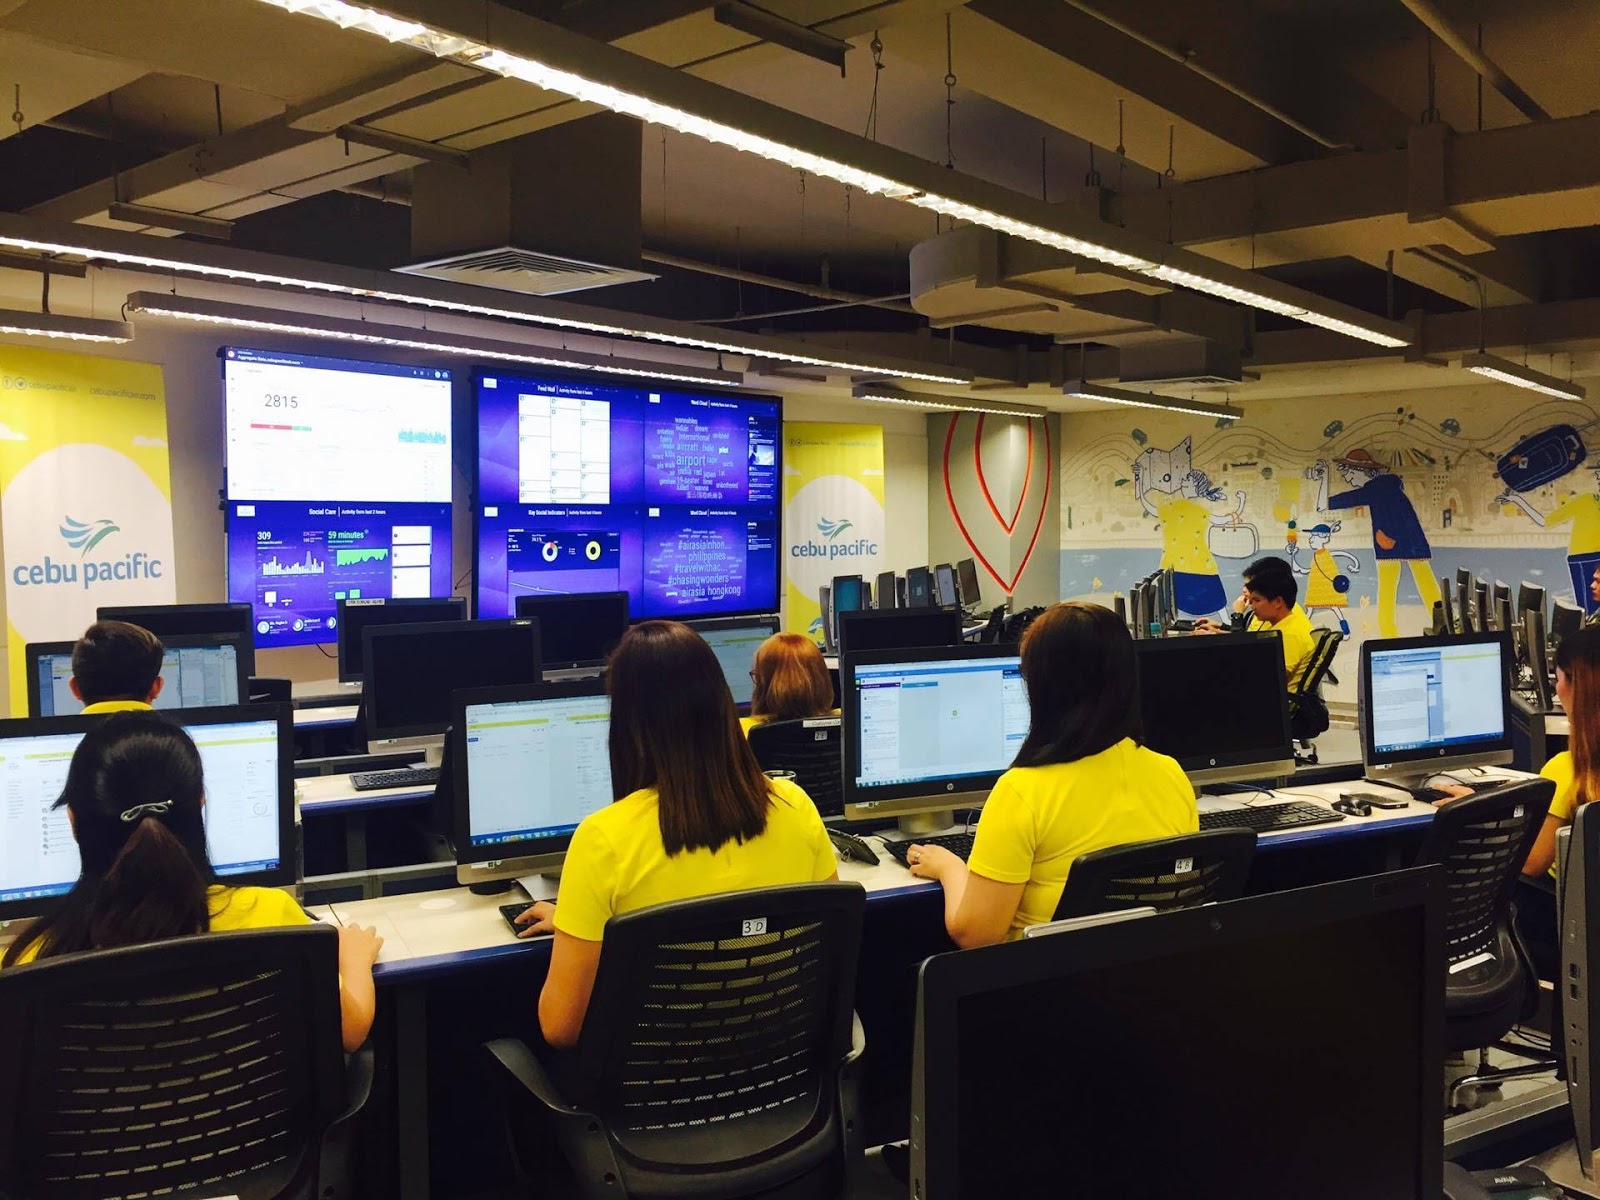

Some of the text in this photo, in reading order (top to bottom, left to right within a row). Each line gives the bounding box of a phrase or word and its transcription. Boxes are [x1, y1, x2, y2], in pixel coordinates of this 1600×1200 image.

[265, 394, 298, 408] 2815
[676, 454, 706, 467] airport
[257, 531, 272, 540] 309
[328, 531, 337, 539] 59
[338, 530, 364, 539] minutes
[791, 539, 878, 560] cebu pacific
[688, 551, 726, 563] philippines
[13, 552, 162, 589] cebu pacific
[668, 574, 729, 586] #chasingwonders
[681, 586, 705, 597] airasia
[708, 584, 741, 596] hongkong
[1494, 1175, 1519, 1184] AVAYA
